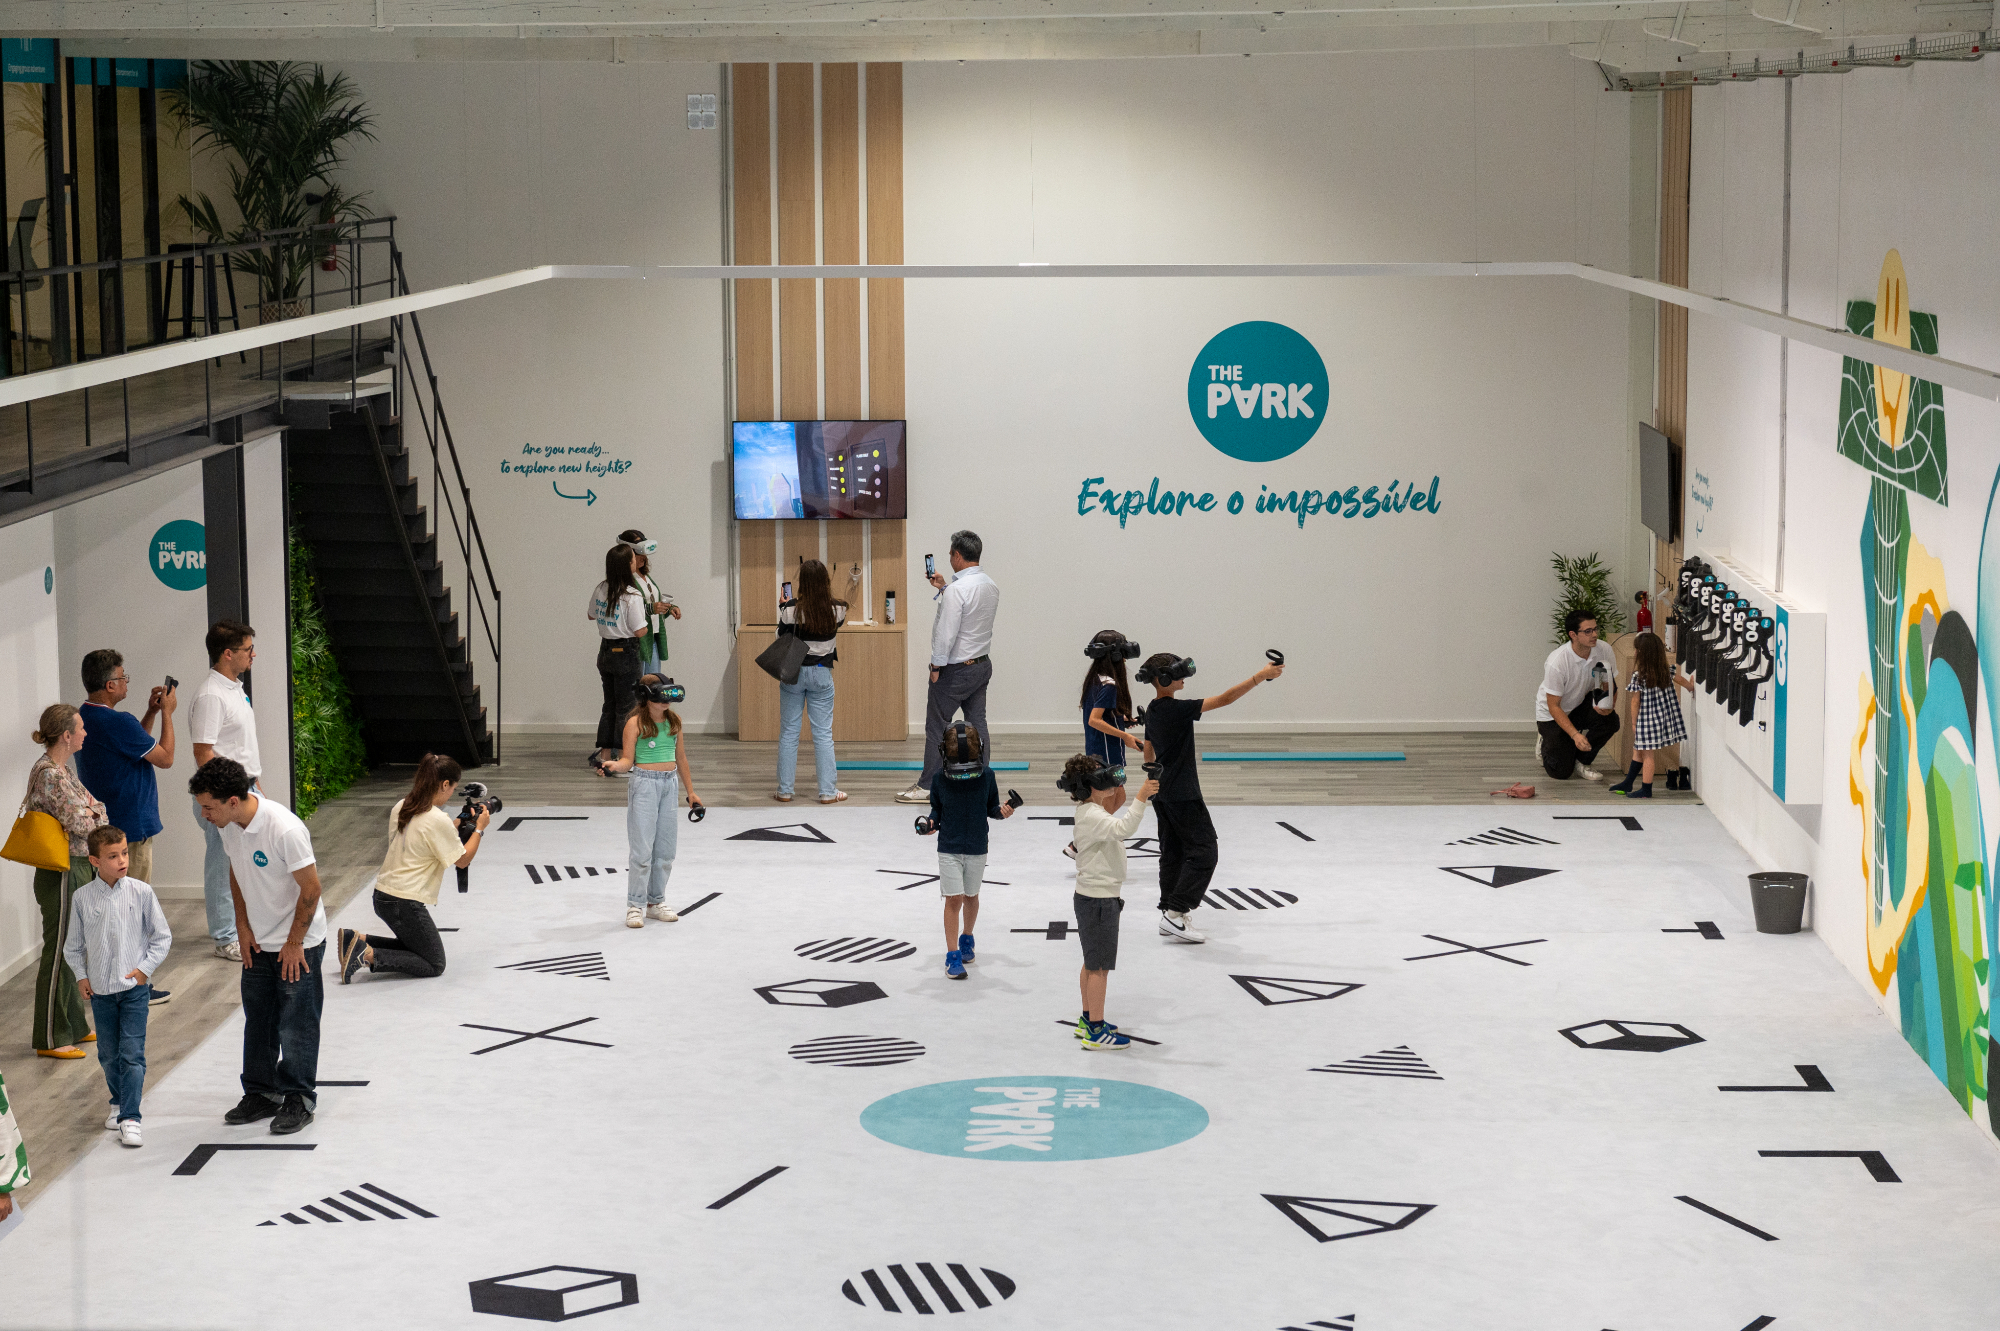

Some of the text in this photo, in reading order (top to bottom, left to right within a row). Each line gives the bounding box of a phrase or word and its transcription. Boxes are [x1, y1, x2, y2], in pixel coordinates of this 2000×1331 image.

[1207, 364, 1243, 381] THE
[1207, 382, 1315, 419] PARK
[522, 441, 610, 458] Are you ready...
[500, 458, 633, 478] to explore new heights?
[1077, 475, 1442, 530] Explore o impossível
[158, 542, 176, 550] THE
[1691, 578, 1702, 597] 09
[1701, 587, 1713, 606] 08
[1711, 595, 1722, 614] 07
[1722, 603, 1734, 623] 06
[1733, 612, 1746, 632] 05
[1746, 620, 1759, 642] 04
[1777, 622, 1787, 686] 3
[1062, 1086, 1101, 1109] THE
[963, 1086, 1057, 1152] PARK
